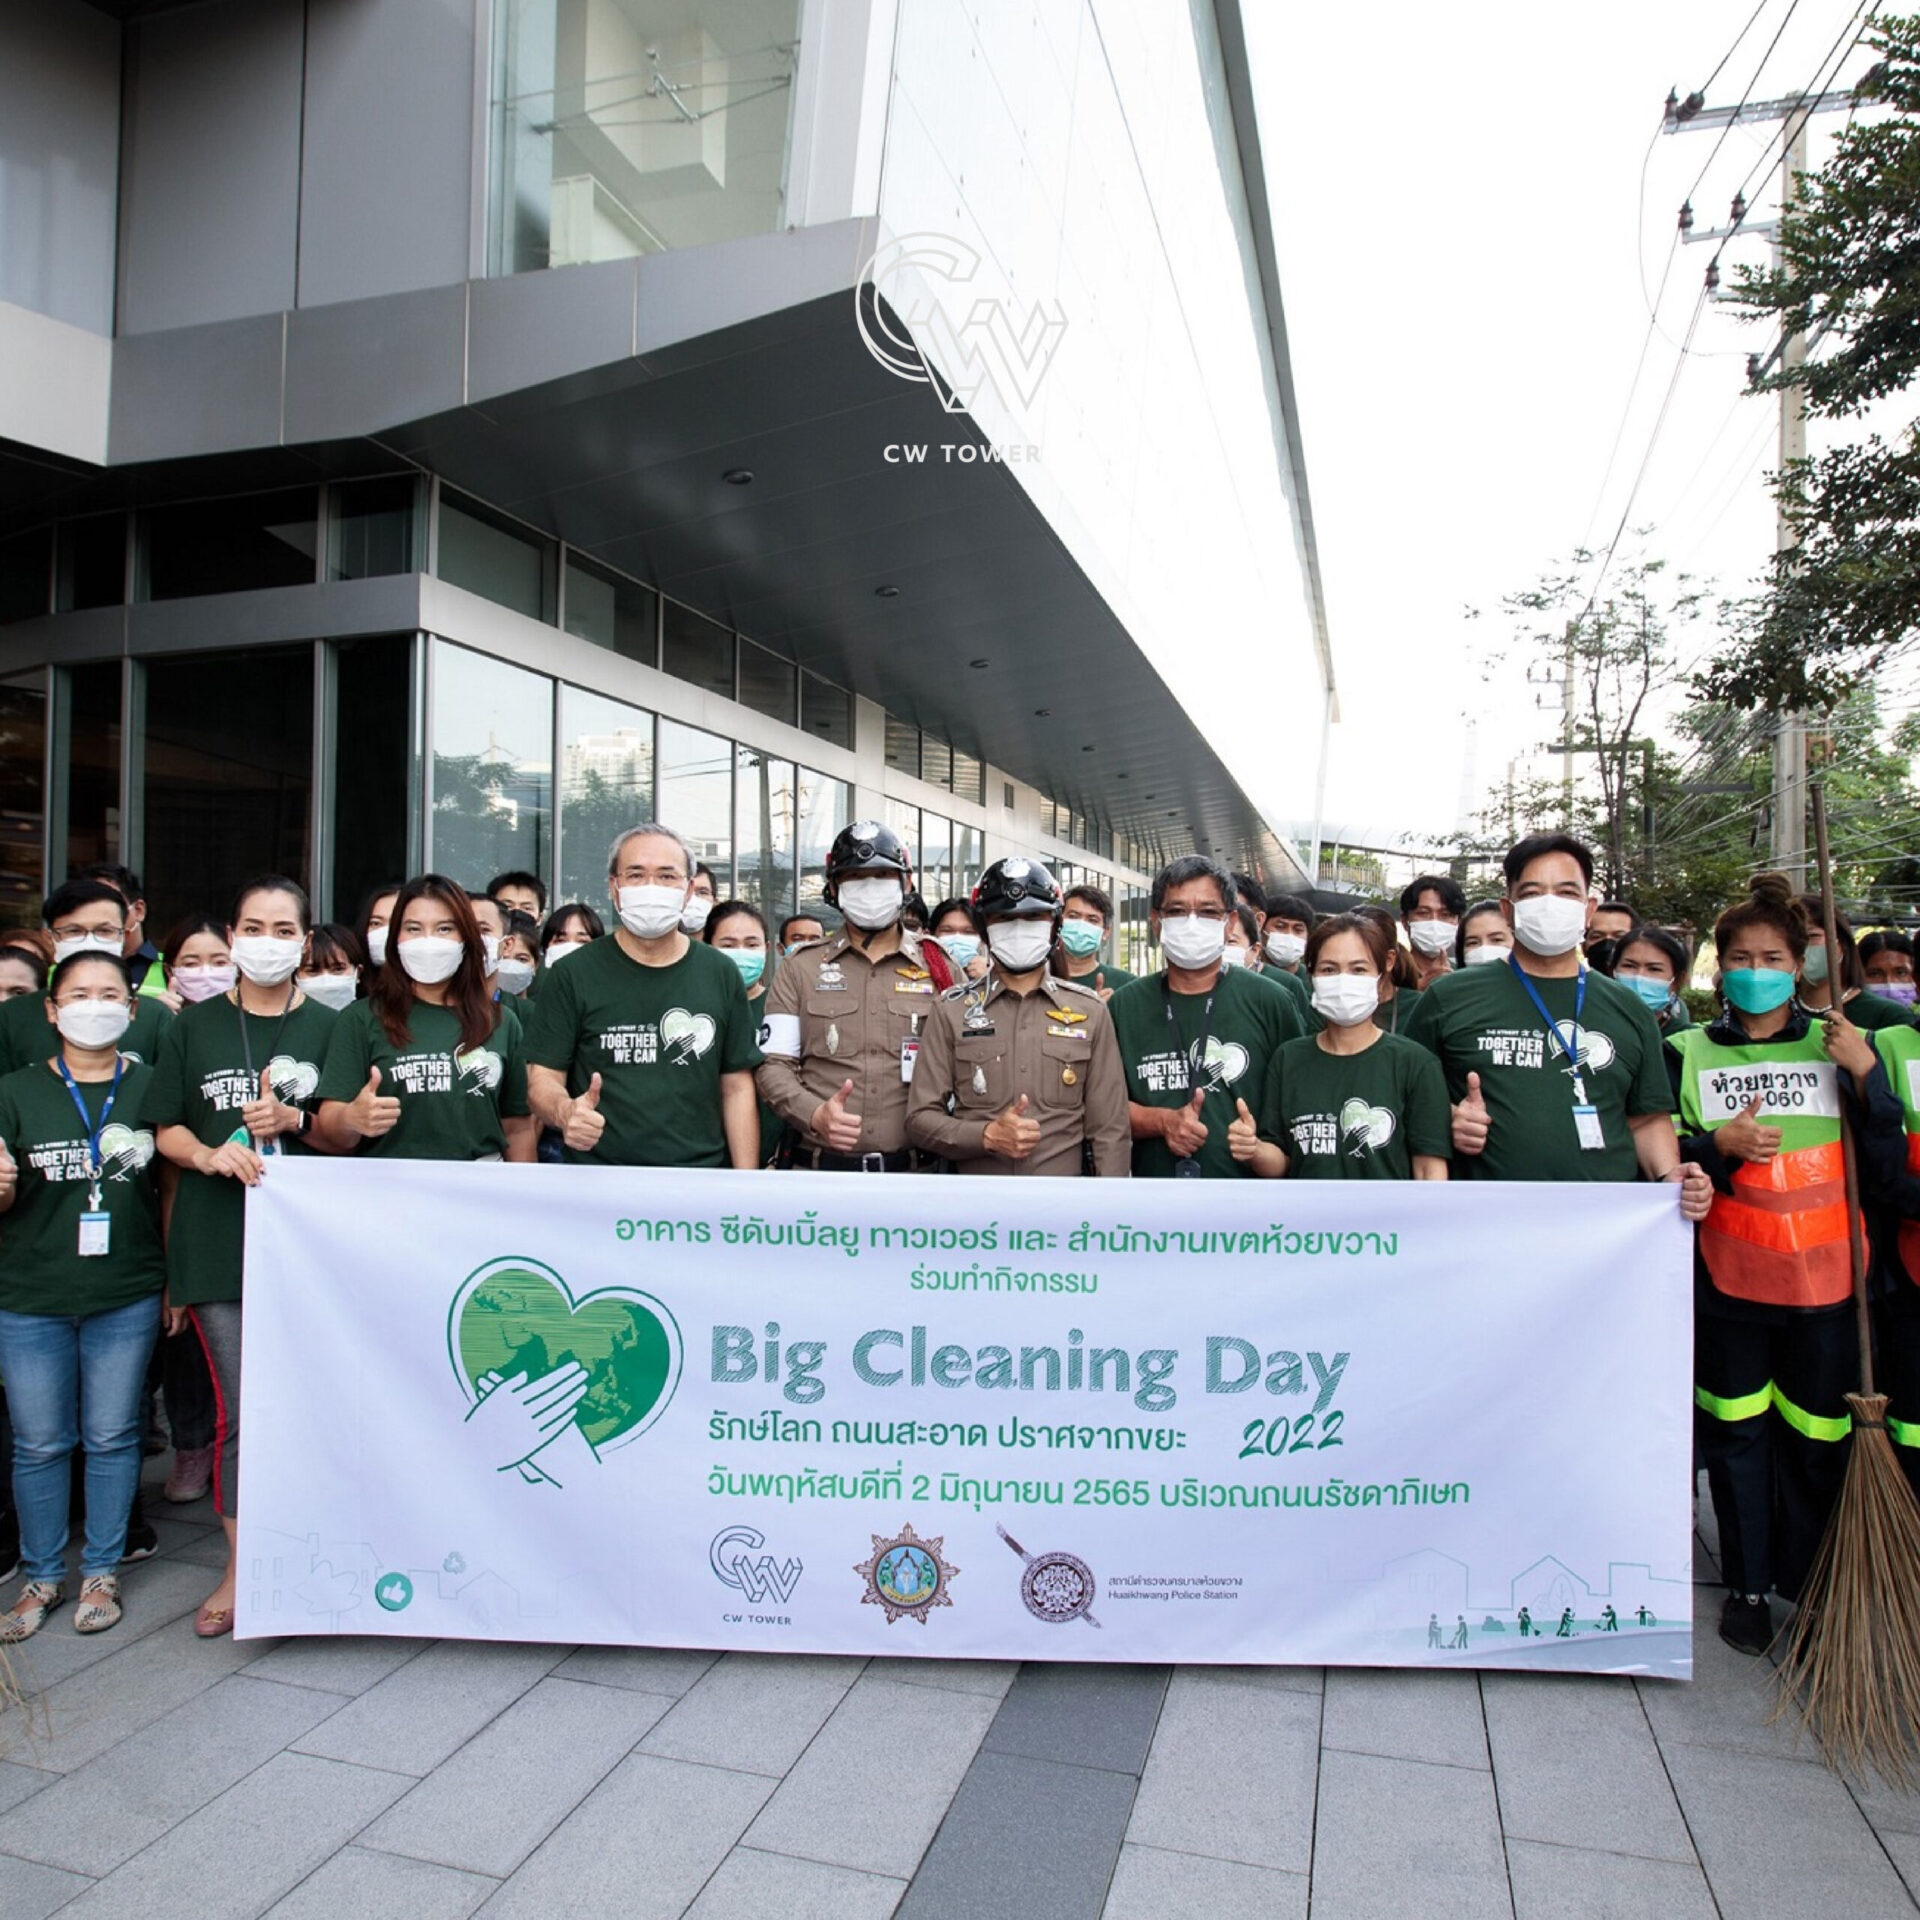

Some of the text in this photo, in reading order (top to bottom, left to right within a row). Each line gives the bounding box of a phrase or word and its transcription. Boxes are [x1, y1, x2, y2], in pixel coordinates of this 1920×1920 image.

[600, 1033, 657, 1049] TOGETHER
[1477, 1036, 1544, 1053] TOGETHER
[614, 1048, 657, 1063] WE CAN
[1492, 1049, 1543, 1068] WE CAN
[390, 1060, 452, 1082] TOGETHER
[405, 1076, 452, 1093] WE CAN
[1147, 1075, 1190, 1091] WE CAN
[1711, 1071, 1819, 1095] ห้วยขวาง
[1311, 1138, 1337, 1155] CAN
[44, 1164, 87, 1181] WE CA
[616, 1211, 1398, 1257] อาคาร ซีดับเบิ้ลยู ทาวเวอร์ และ สำนักงานเขตห้วยขวาง
[910, 1263, 1098, 1294] ร่วมทำกิจกรรม
[711, 1321, 1351, 1414] Big Cleaning Day
[708, 1409, 1187, 1451] รักษ์โลก ถนนสะอาด ปราศจากขยะ
[1239, 1410, 1344, 1460] 2022
[708, 1460, 1470, 1512] วันพฤหัสบดีที่ 2 มิถุนายน 2565 บริเวณถนนรัชดาภิเษก
[1170, 1590, 1201, 1600] Police
[1202, 1590, 1238, 1600] Station
[722, 1613, 792, 1626] CW TOWER
